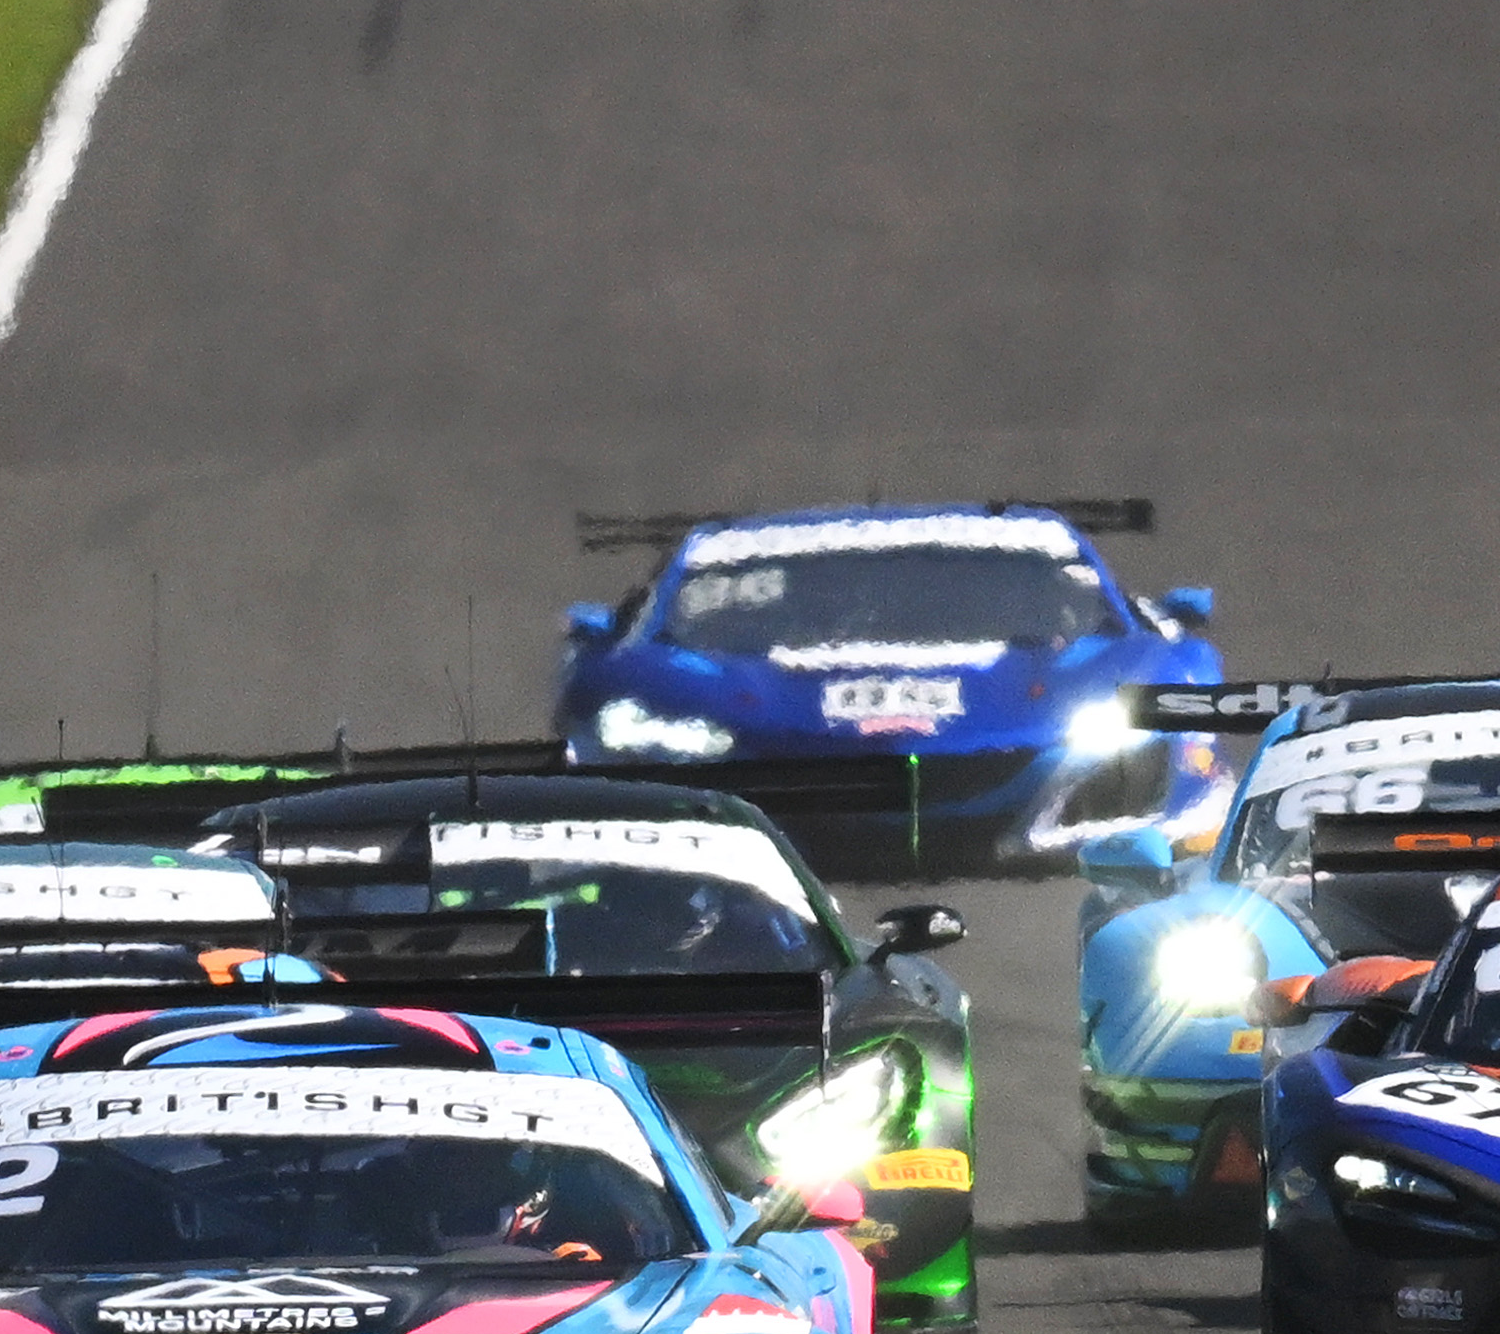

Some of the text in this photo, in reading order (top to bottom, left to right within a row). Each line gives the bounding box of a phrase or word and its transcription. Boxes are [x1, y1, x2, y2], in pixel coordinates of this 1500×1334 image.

[1275, 769, 1428, 831] 66
[100, 1307, 346, 1323] MILLIMETRES
[124, 1315, 358, 1333] MOUNTAINS
